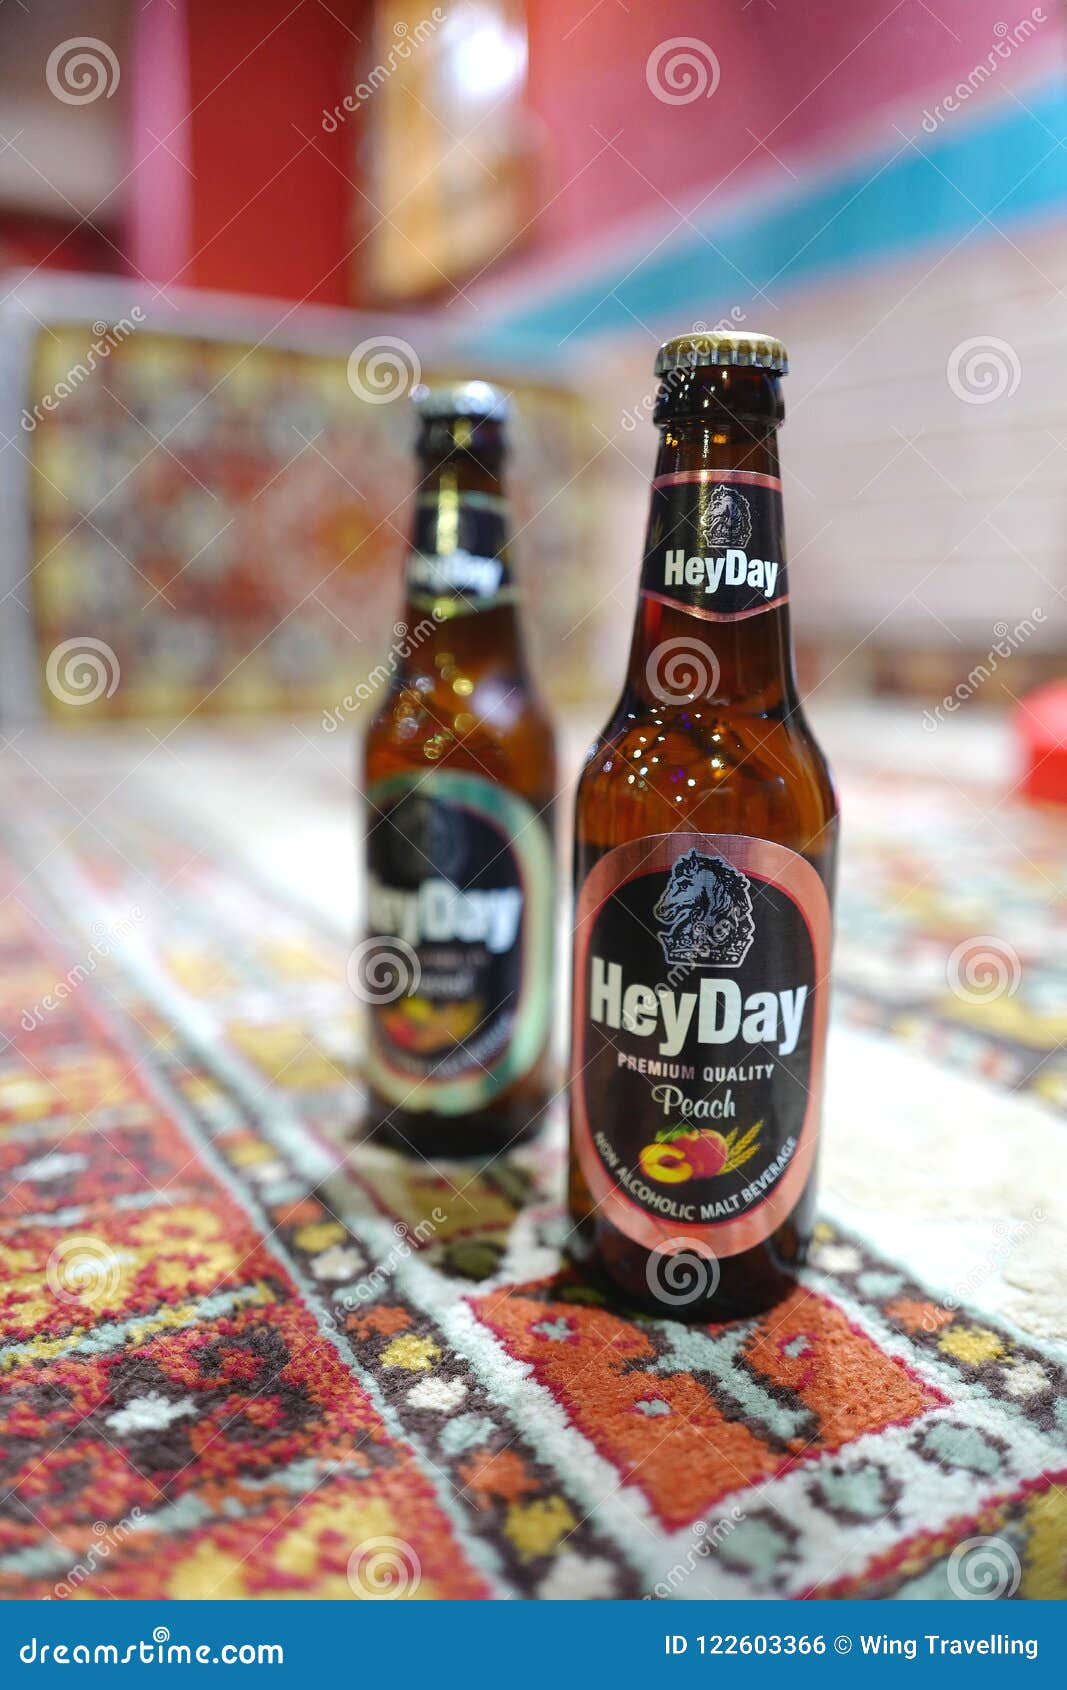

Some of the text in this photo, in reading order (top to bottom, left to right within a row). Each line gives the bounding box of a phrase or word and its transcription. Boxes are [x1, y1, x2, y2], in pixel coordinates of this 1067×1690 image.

[664, 549, 779, 598] HeyDay
[590, 956, 808, 1057] HeyDay
[617, 1052, 775, 1082] PREMIUM QUALITY
[651, 1084, 736, 1119] Peach
[594, 1131, 798, 1220] NON ALCOHOLIC MALT BEVERAGE
